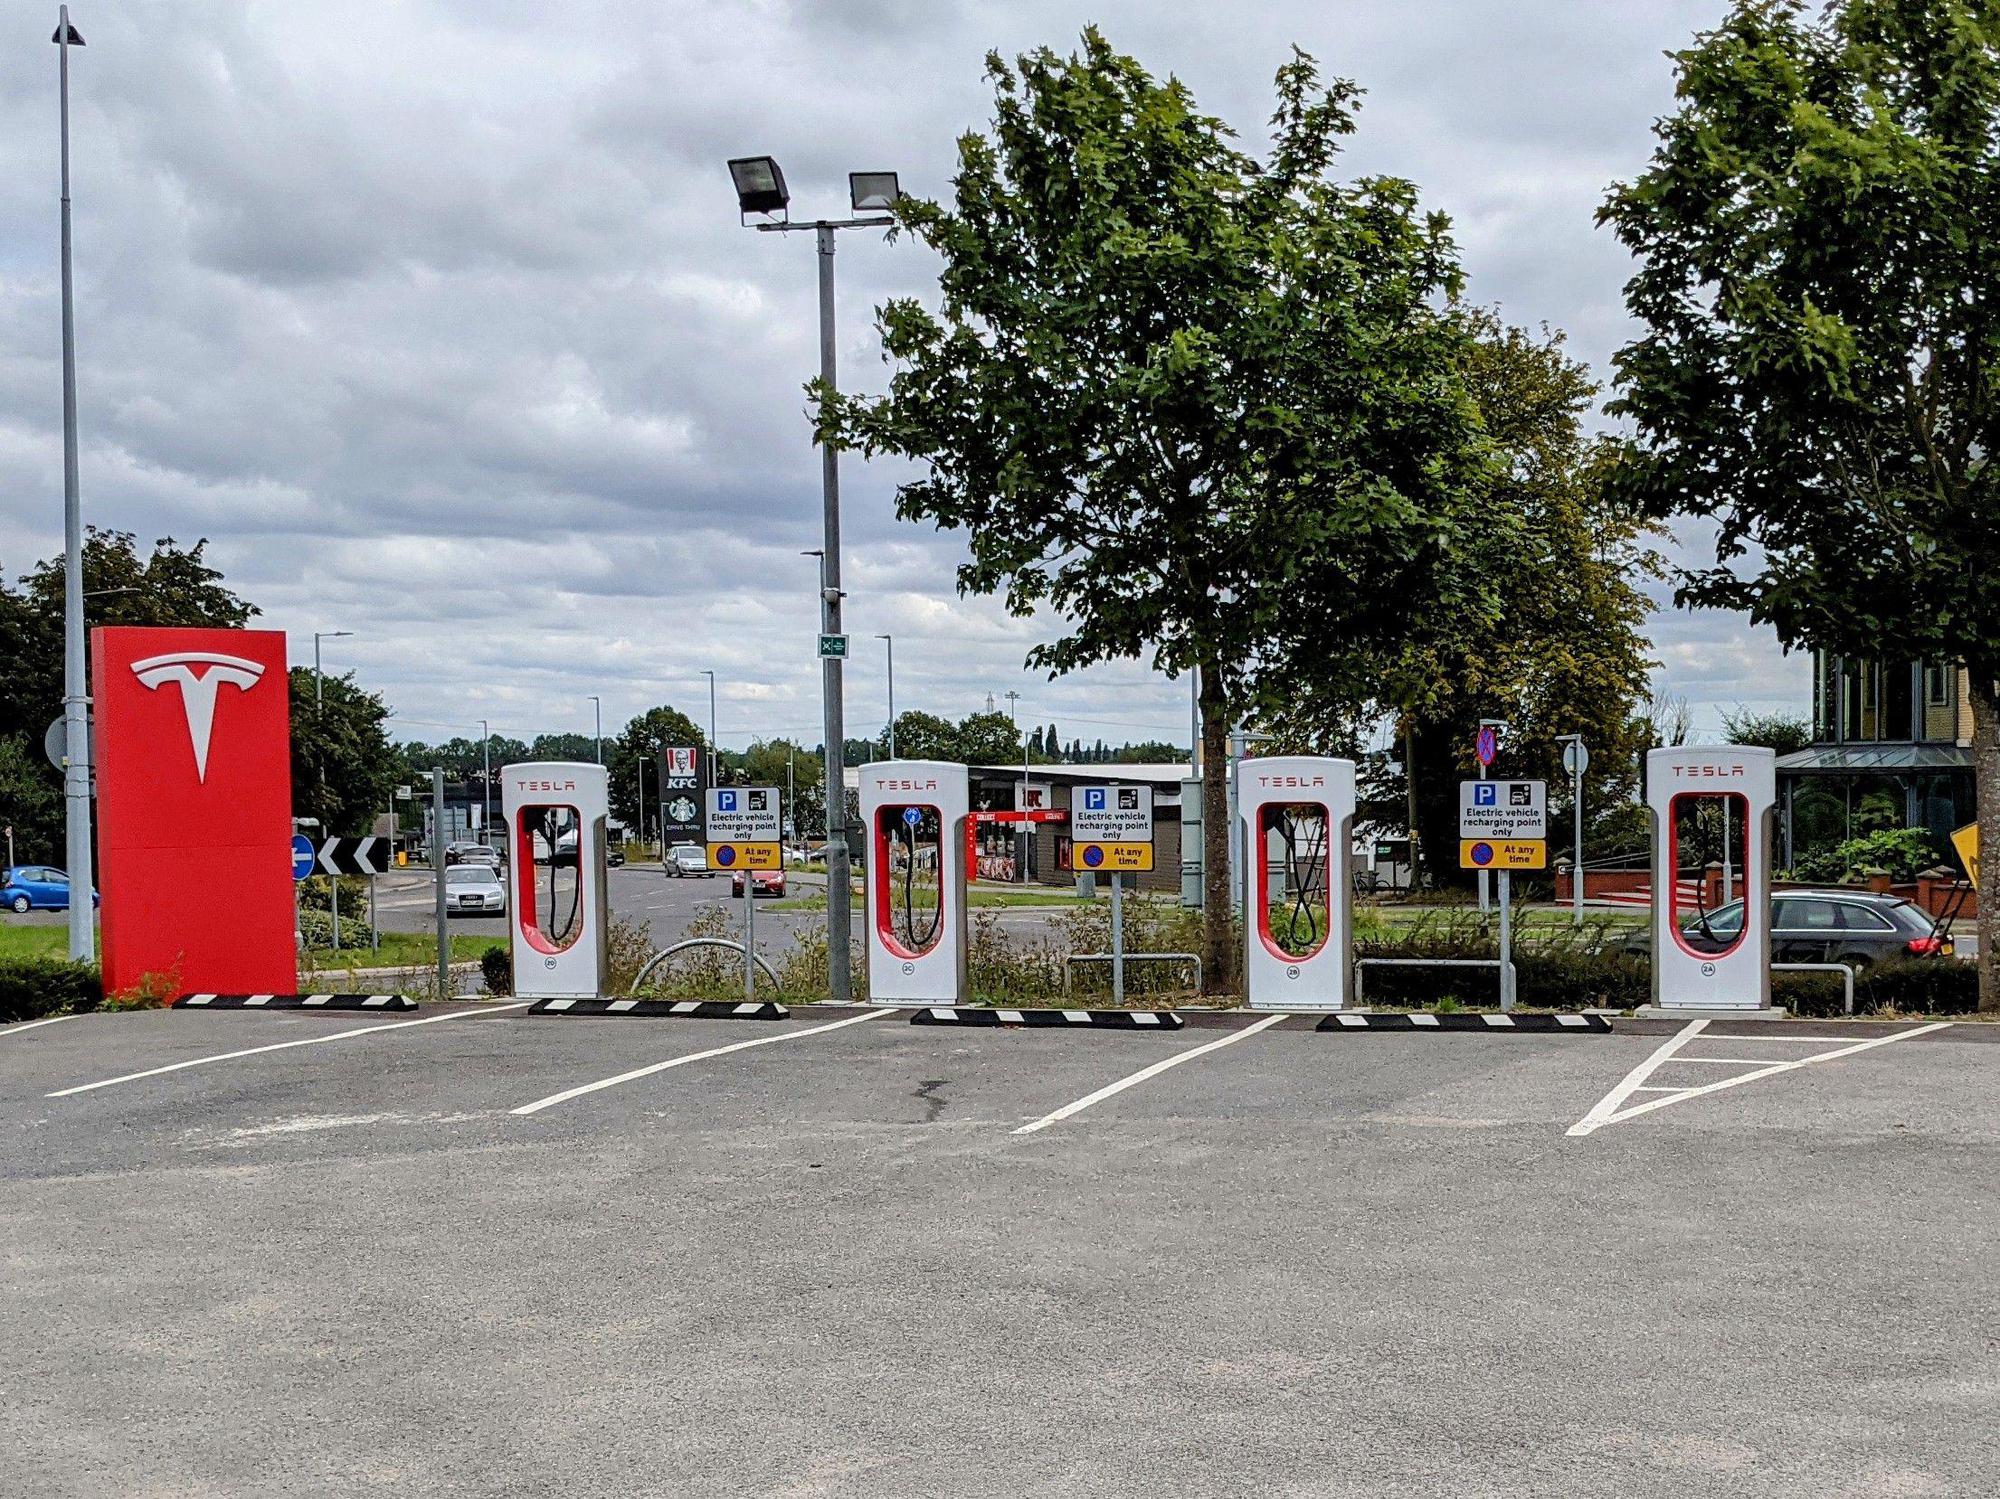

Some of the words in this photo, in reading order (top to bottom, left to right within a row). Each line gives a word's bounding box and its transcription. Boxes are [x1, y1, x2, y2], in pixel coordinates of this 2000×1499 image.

[1671, 766, 1744, 777] TESLA
[517, 781, 575, 791] TESLA
[666, 778, 698, 789] KFC
[876, 780, 937, 790] TESLA
[1258, 776, 1324, 787] TESLA
[1089, 791, 1102, 808] P
[1479, 786, 1492, 804] P
[722, 793, 733, 809] P
[1078, 812, 1113, 820] Electric
[1115, 812, 1146, 820] vehicle
[1466, 808, 1503, 816] Electric
[1505, 808, 1539, 816] vehicle
[711, 813, 743, 821] Electric
[745, 813, 774, 821] vehicle
[709, 823, 753, 831] recharging
[755, 823, 776, 831] point
[1075, 822, 1122, 831] recharging
[1125, 822, 1148, 830] point
[1463, 818, 1514, 827] recharging
[1517, 818, 1542, 827] point
[734, 832, 752, 840] only
[1102, 831, 1121, 840] only
[1492, 828, 1513, 837] only
[1114, 848, 1124, 856] At
[1126, 849, 1143, 857] any
[1504, 845, 1516, 853] At
[1518, 846, 1535, 854] any
[1118, 857, 1138, 865] time
[1509, 855, 1530, 863] time
